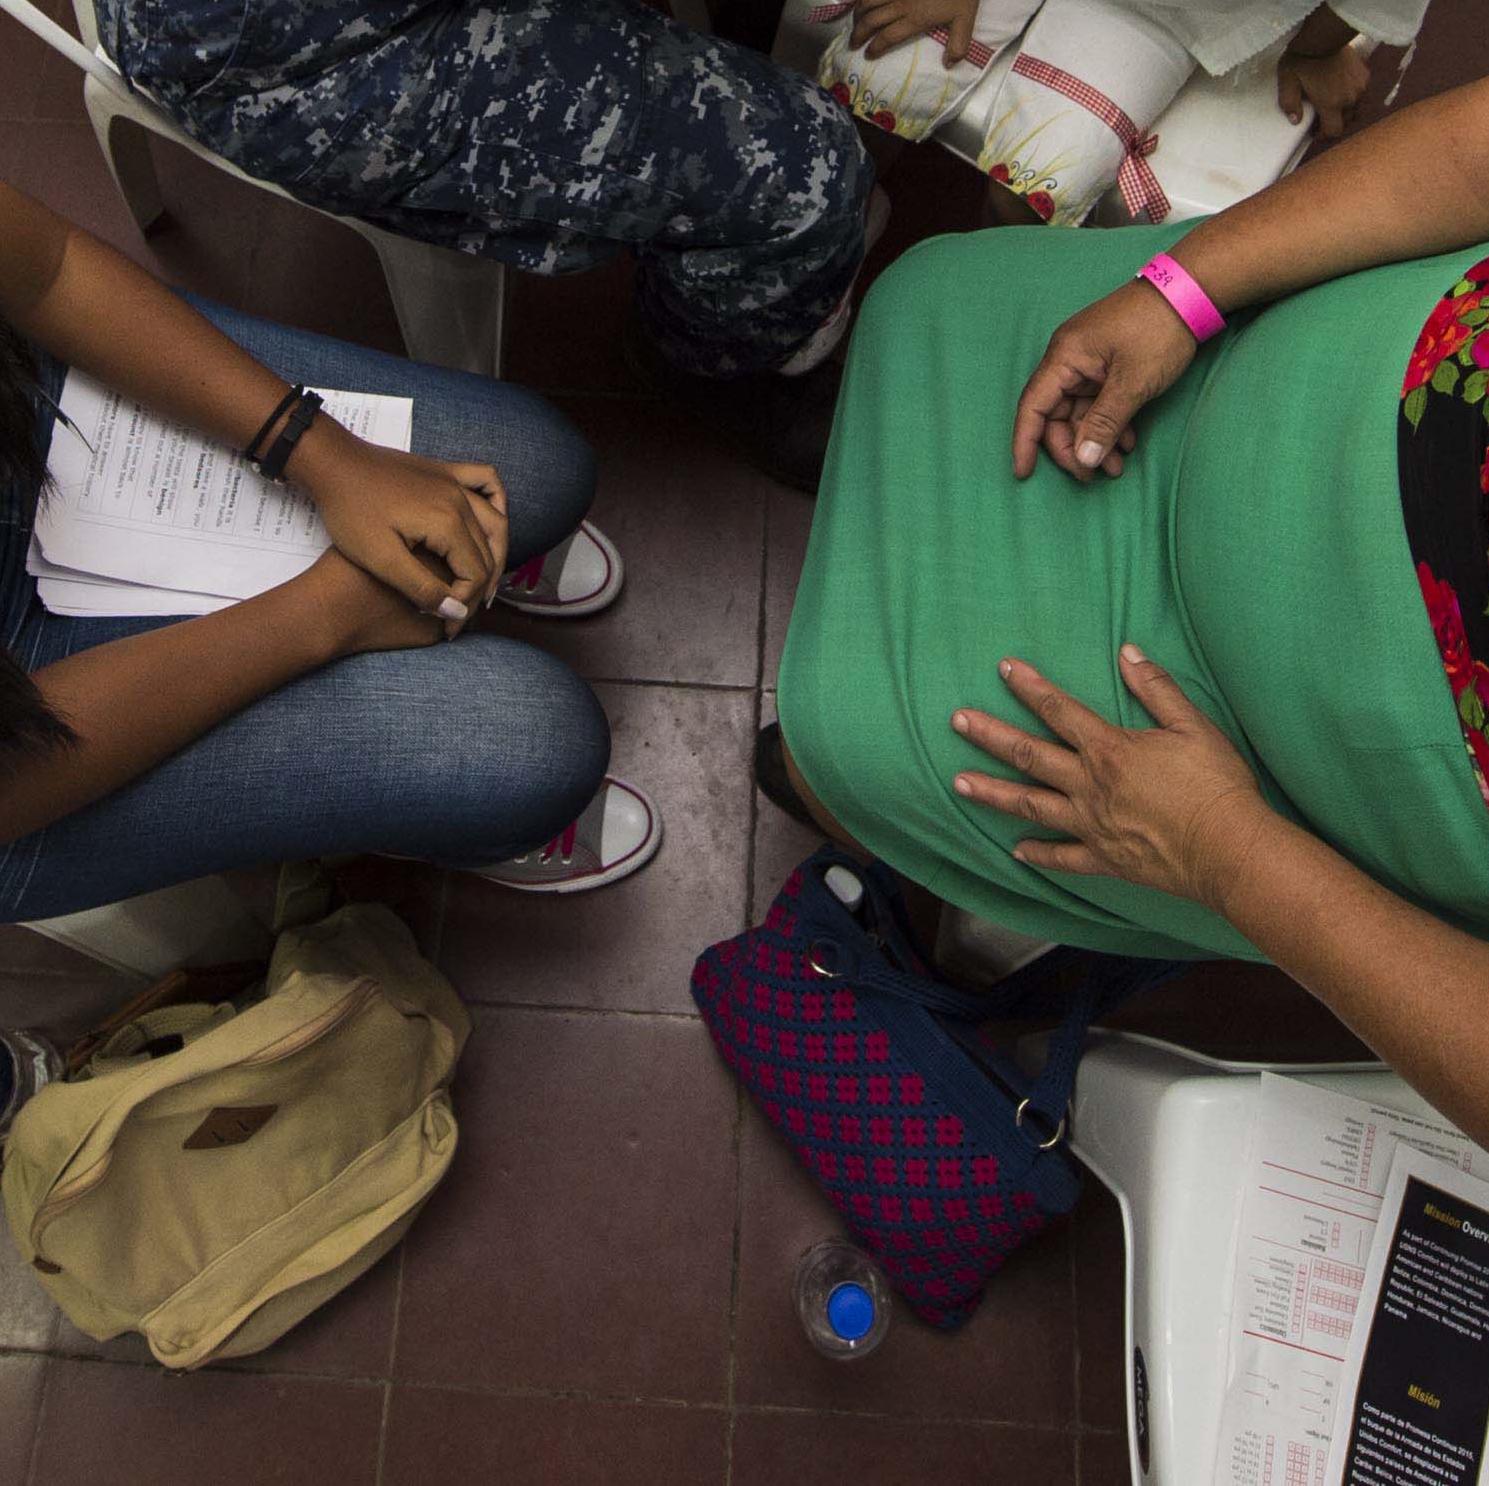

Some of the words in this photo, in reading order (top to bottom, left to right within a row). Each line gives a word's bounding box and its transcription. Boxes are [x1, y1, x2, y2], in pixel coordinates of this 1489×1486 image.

[192, 452, 206, 489] bedsores
[1422, 1202, 1463, 1229] Mission
[1361, 1401, 1381, 1416] Como
[1407, 1383, 1441, 1410] Misión
